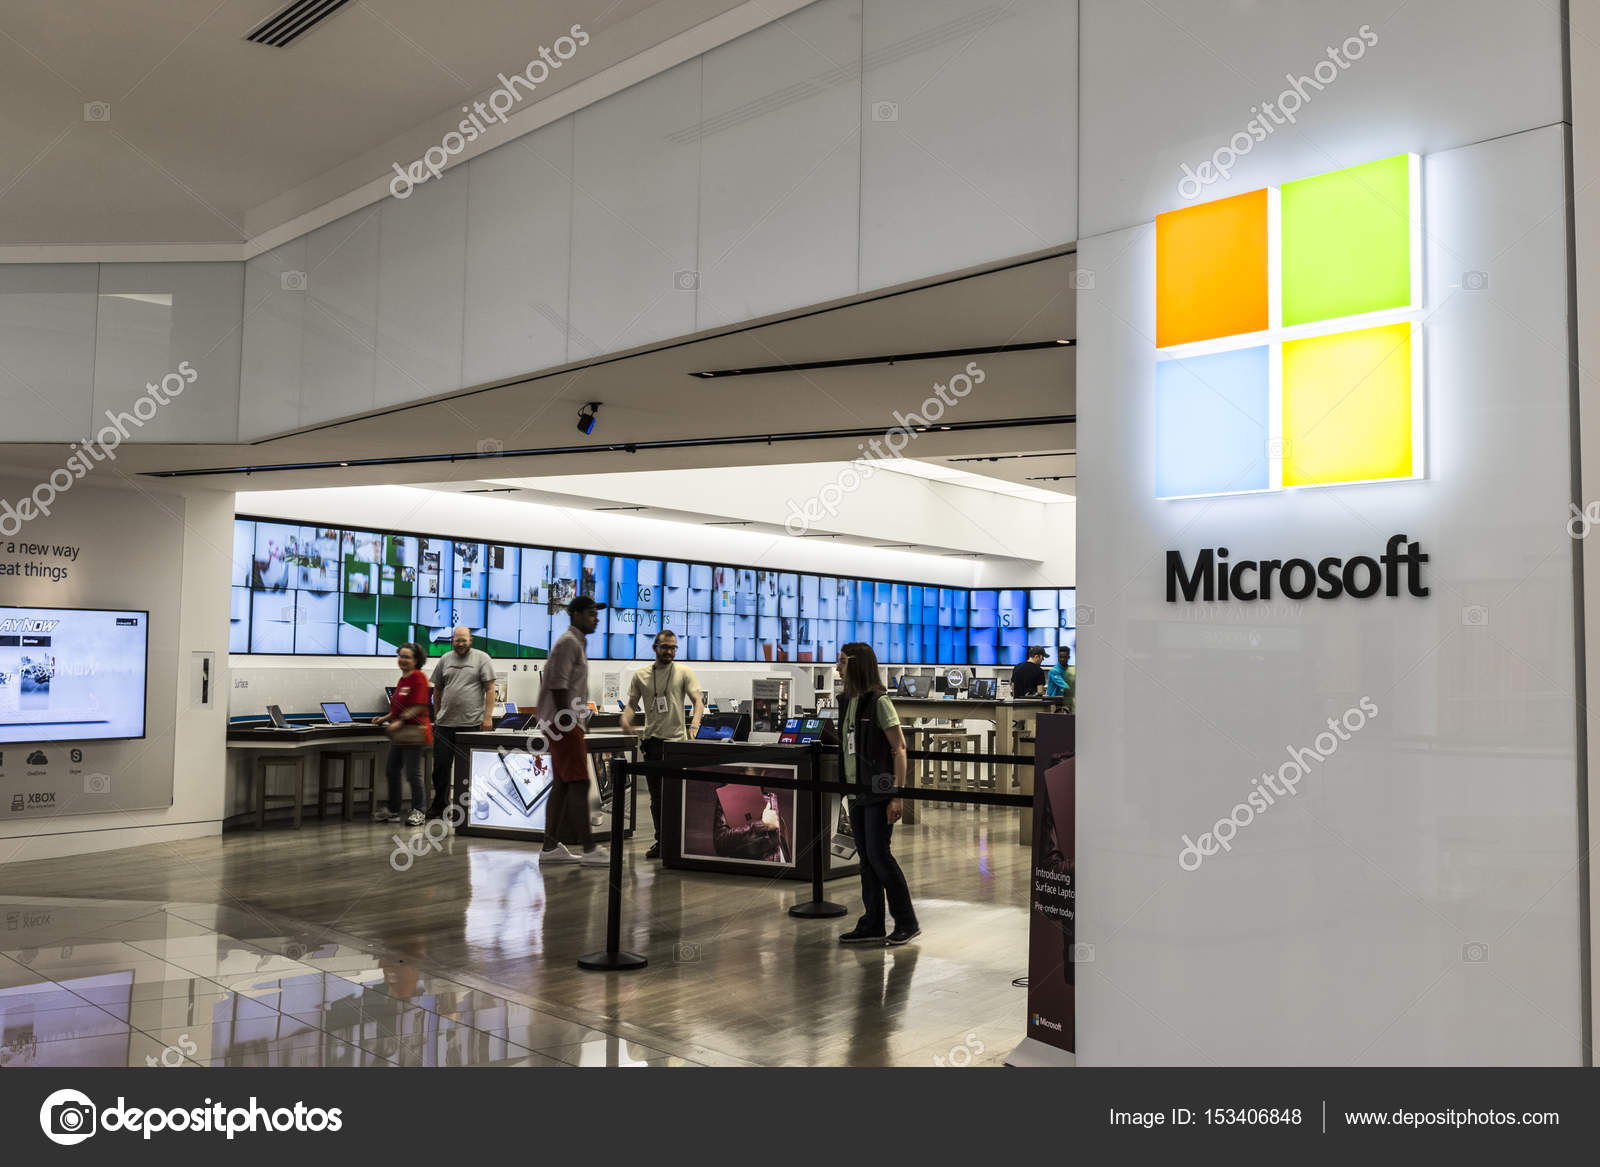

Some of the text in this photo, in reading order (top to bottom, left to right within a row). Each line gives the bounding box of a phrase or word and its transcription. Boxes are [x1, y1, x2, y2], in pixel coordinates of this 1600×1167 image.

[7, 542, 15, 553] a
[20, 543, 49, 556] new
[52, 546, 80, 562] way
[0, 562, 68, 582] eat things
[1165, 533, 1430, 602] Microsoft
[616, 582, 652, 603] Mke
[28, 792, 56, 803] XBOX
[1036, 867, 1070, 885] Introducing
[1035, 881, 1057, 895] Surface
[1060, 907, 1074, 920] today
[1040, 1016, 1062, 1032] Microsoft
